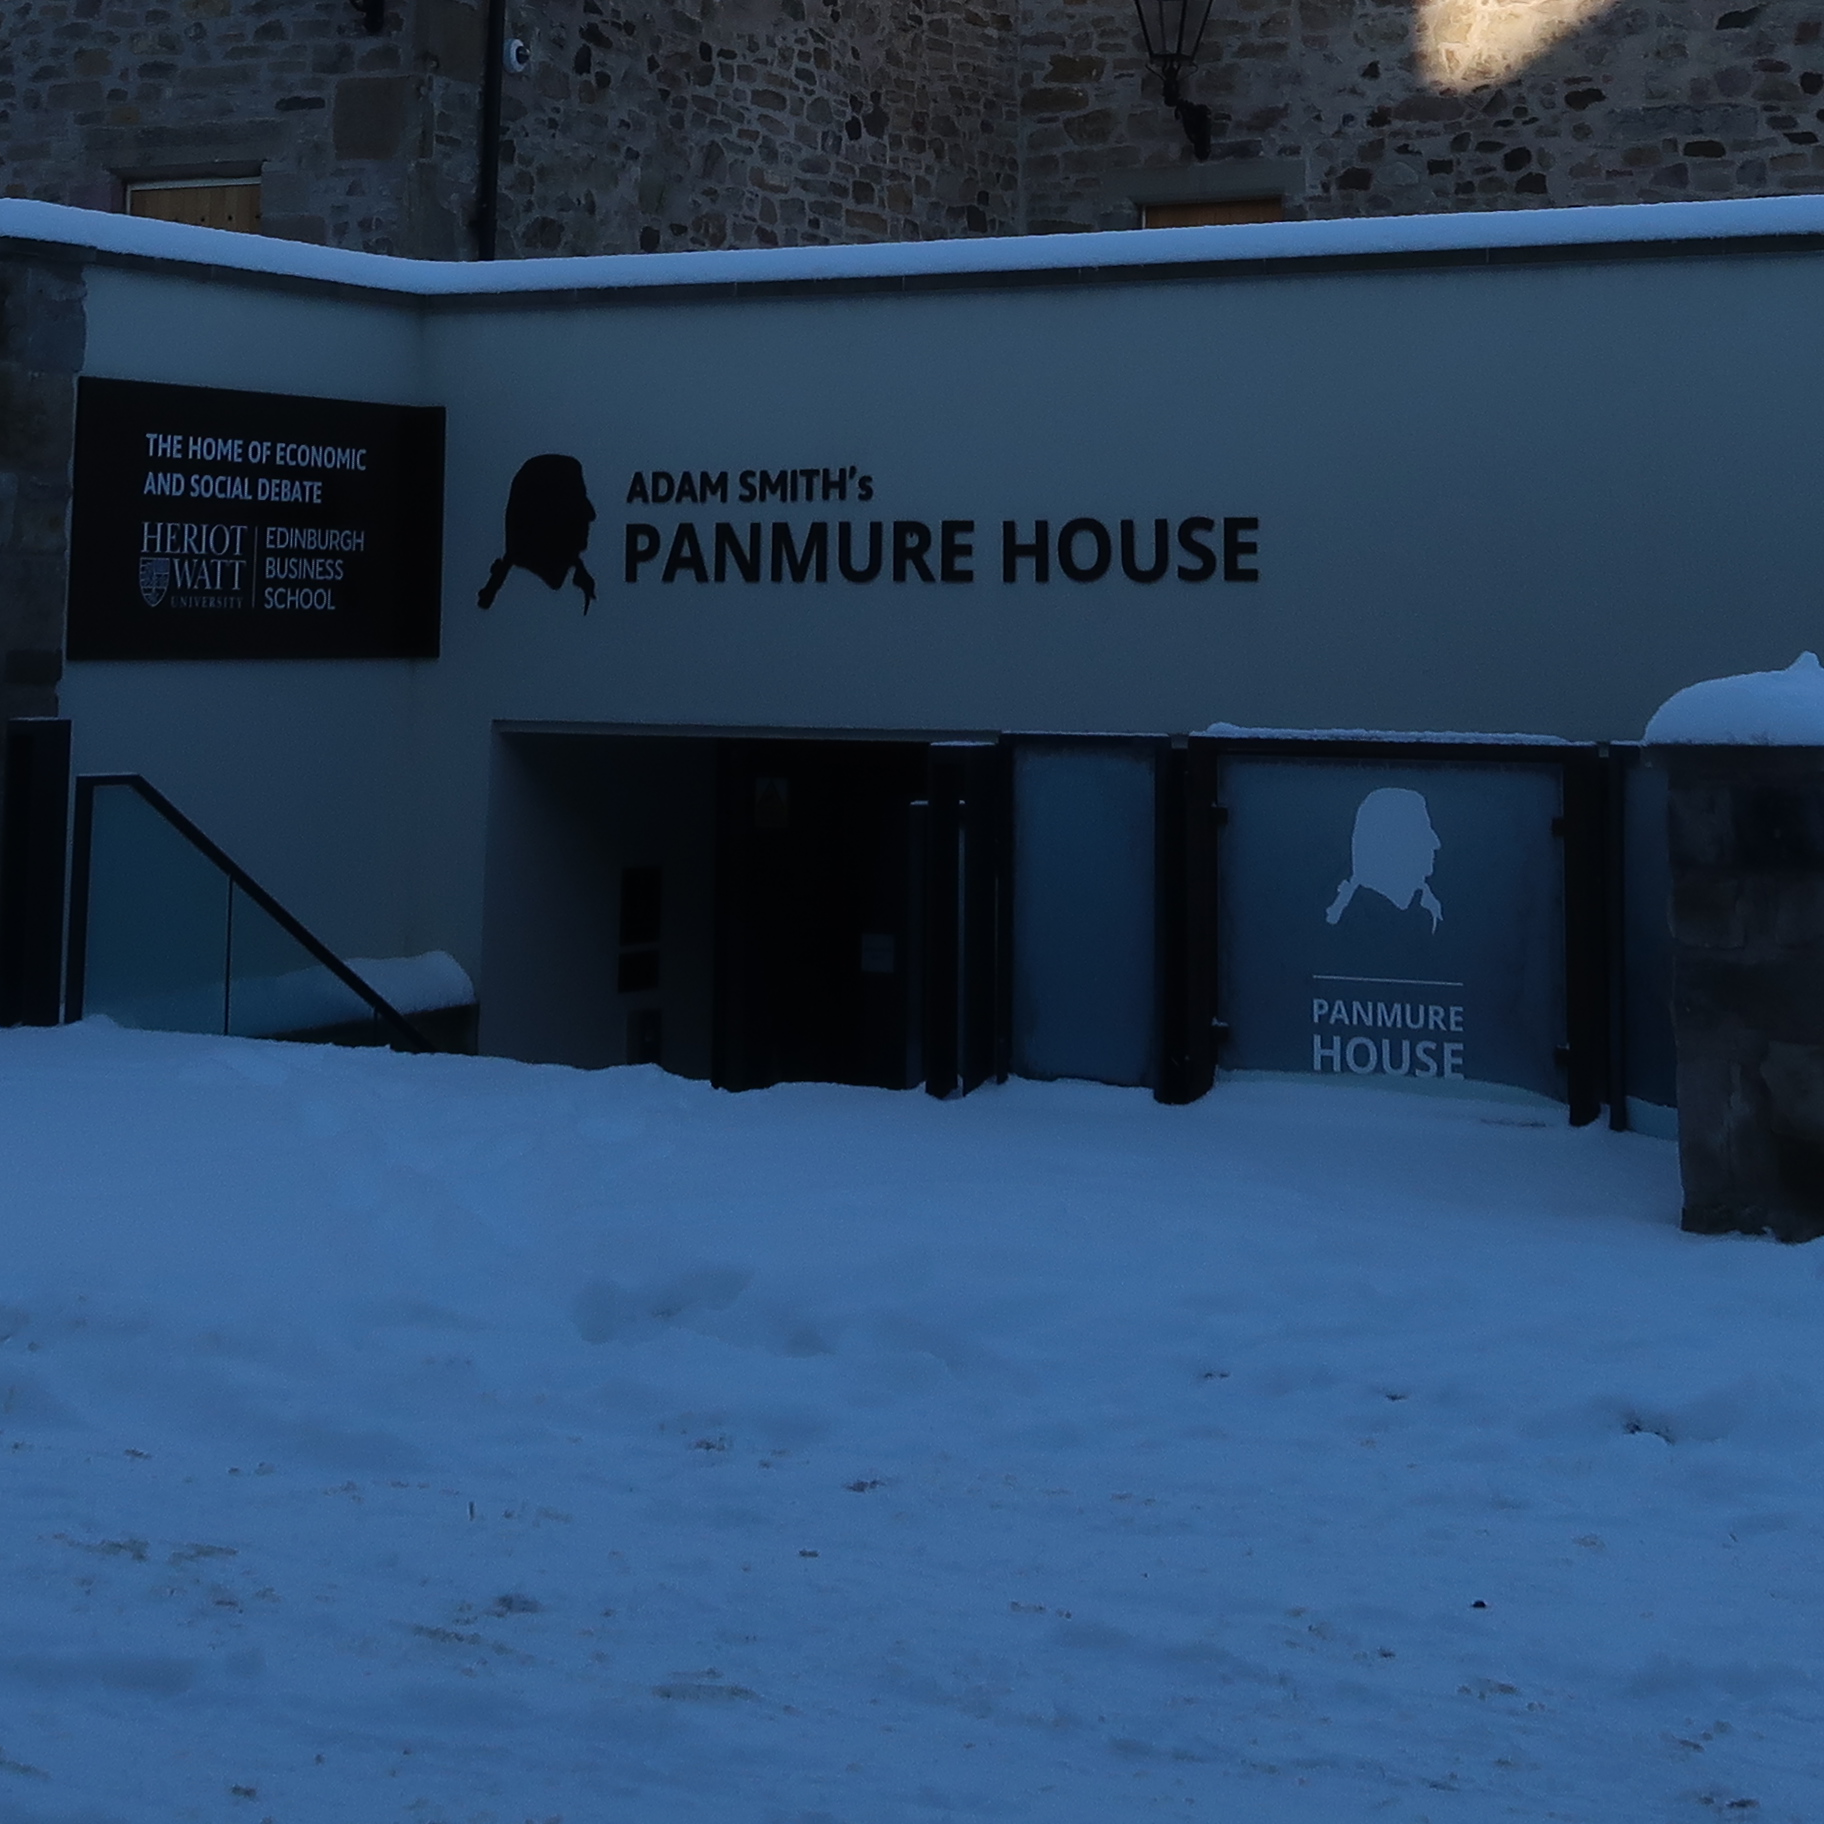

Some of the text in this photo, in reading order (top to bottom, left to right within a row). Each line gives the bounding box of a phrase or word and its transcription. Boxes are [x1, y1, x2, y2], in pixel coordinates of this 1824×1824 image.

[146, 433, 367, 471] THE HOME OF ECONOMIC
[143, 472, 323, 504] AND SOCIAL DEBATE
[627, 467, 873, 504] ADAM SMITH's
[140, 521, 248, 555] HERIOT
[265, 527, 365, 552] EDINBURGH
[625, 517, 1259, 583] PANMURE HOUSE
[170, 559, 247, 590] WATT
[265, 558, 344, 581] BUSINESS
[170, 596, 243, 609] UNIVERSITY
[264, 588, 336, 611] SCHOOL
[1312, 998, 1464, 1032] PANMURE
[1313, 1034, 1465, 1080] HOUSE
